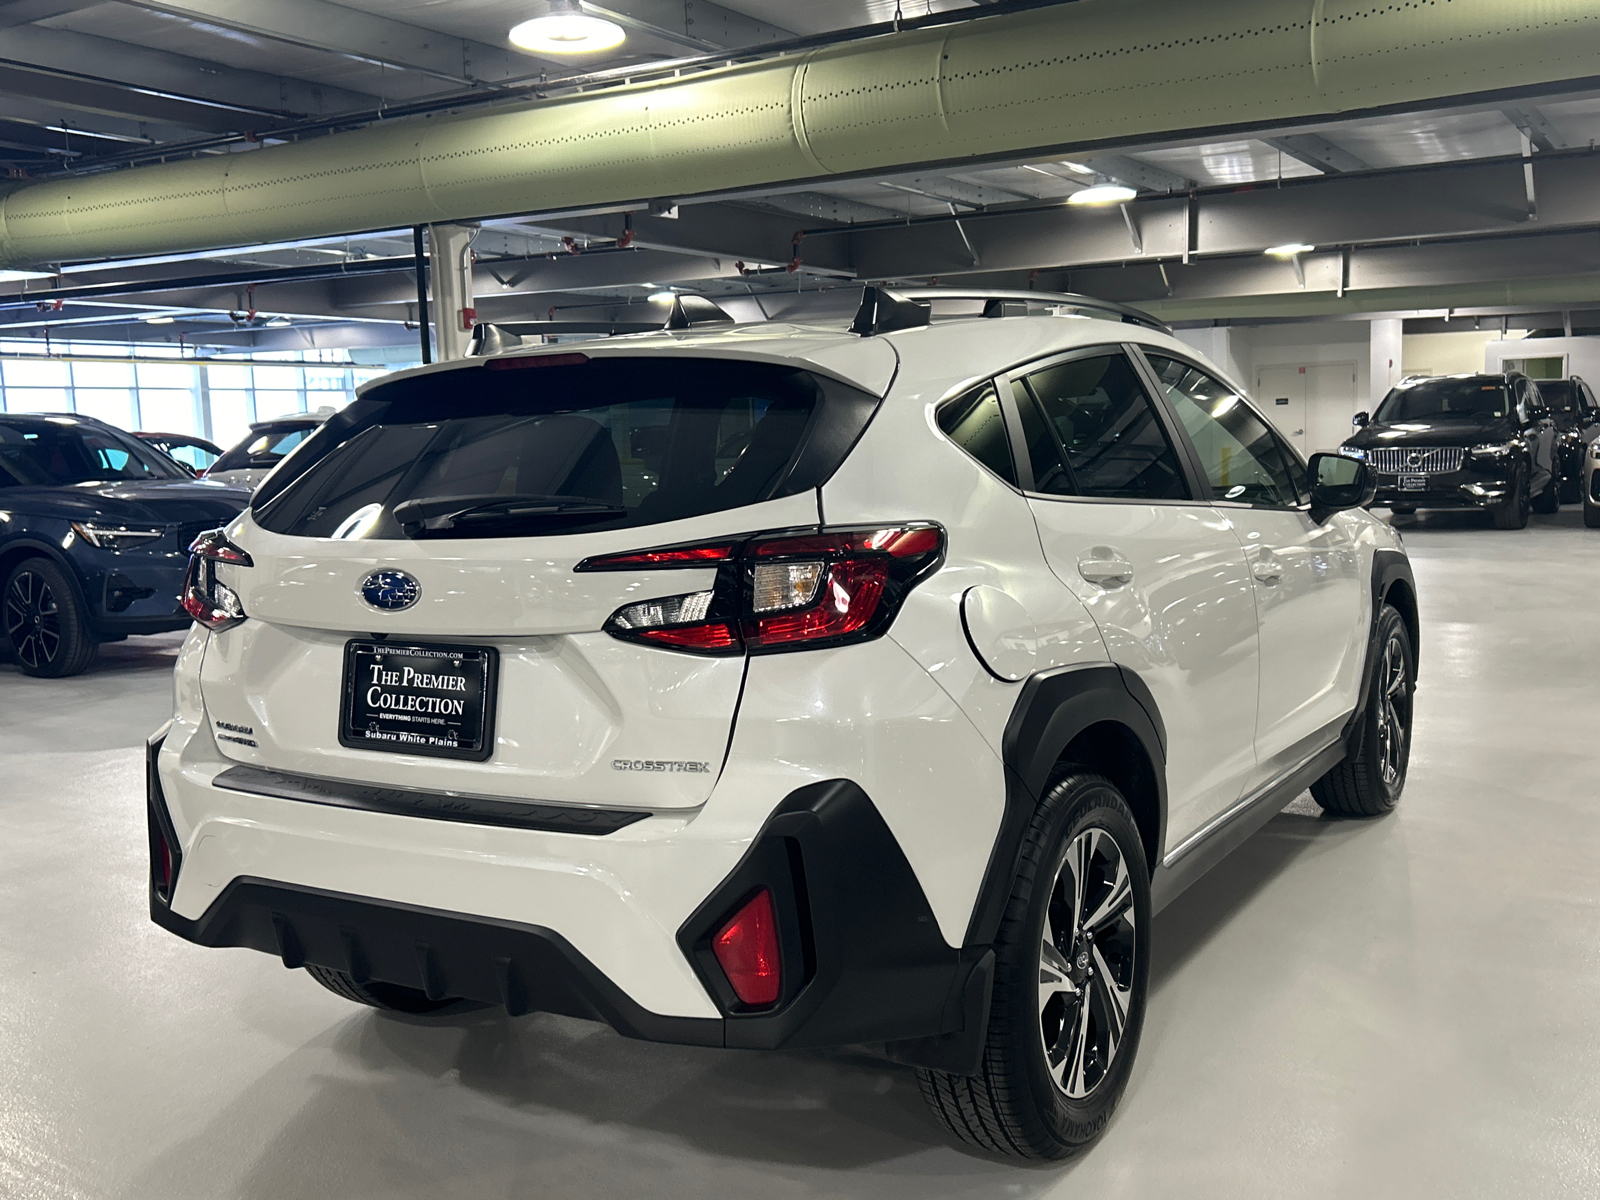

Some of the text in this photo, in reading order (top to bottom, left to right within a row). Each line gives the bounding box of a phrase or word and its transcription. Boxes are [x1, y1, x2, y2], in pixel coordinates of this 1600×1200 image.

[369, 664, 466, 691] THE PREMIER
[366, 686, 465, 716] COLLECTION
[379, 712, 411, 722] EVERYTHING
[411, 715, 431, 724] STARTS
[365, 730, 458, 748] Subaru White Plains
[610, 759, 710, 773] CROSSTREK
